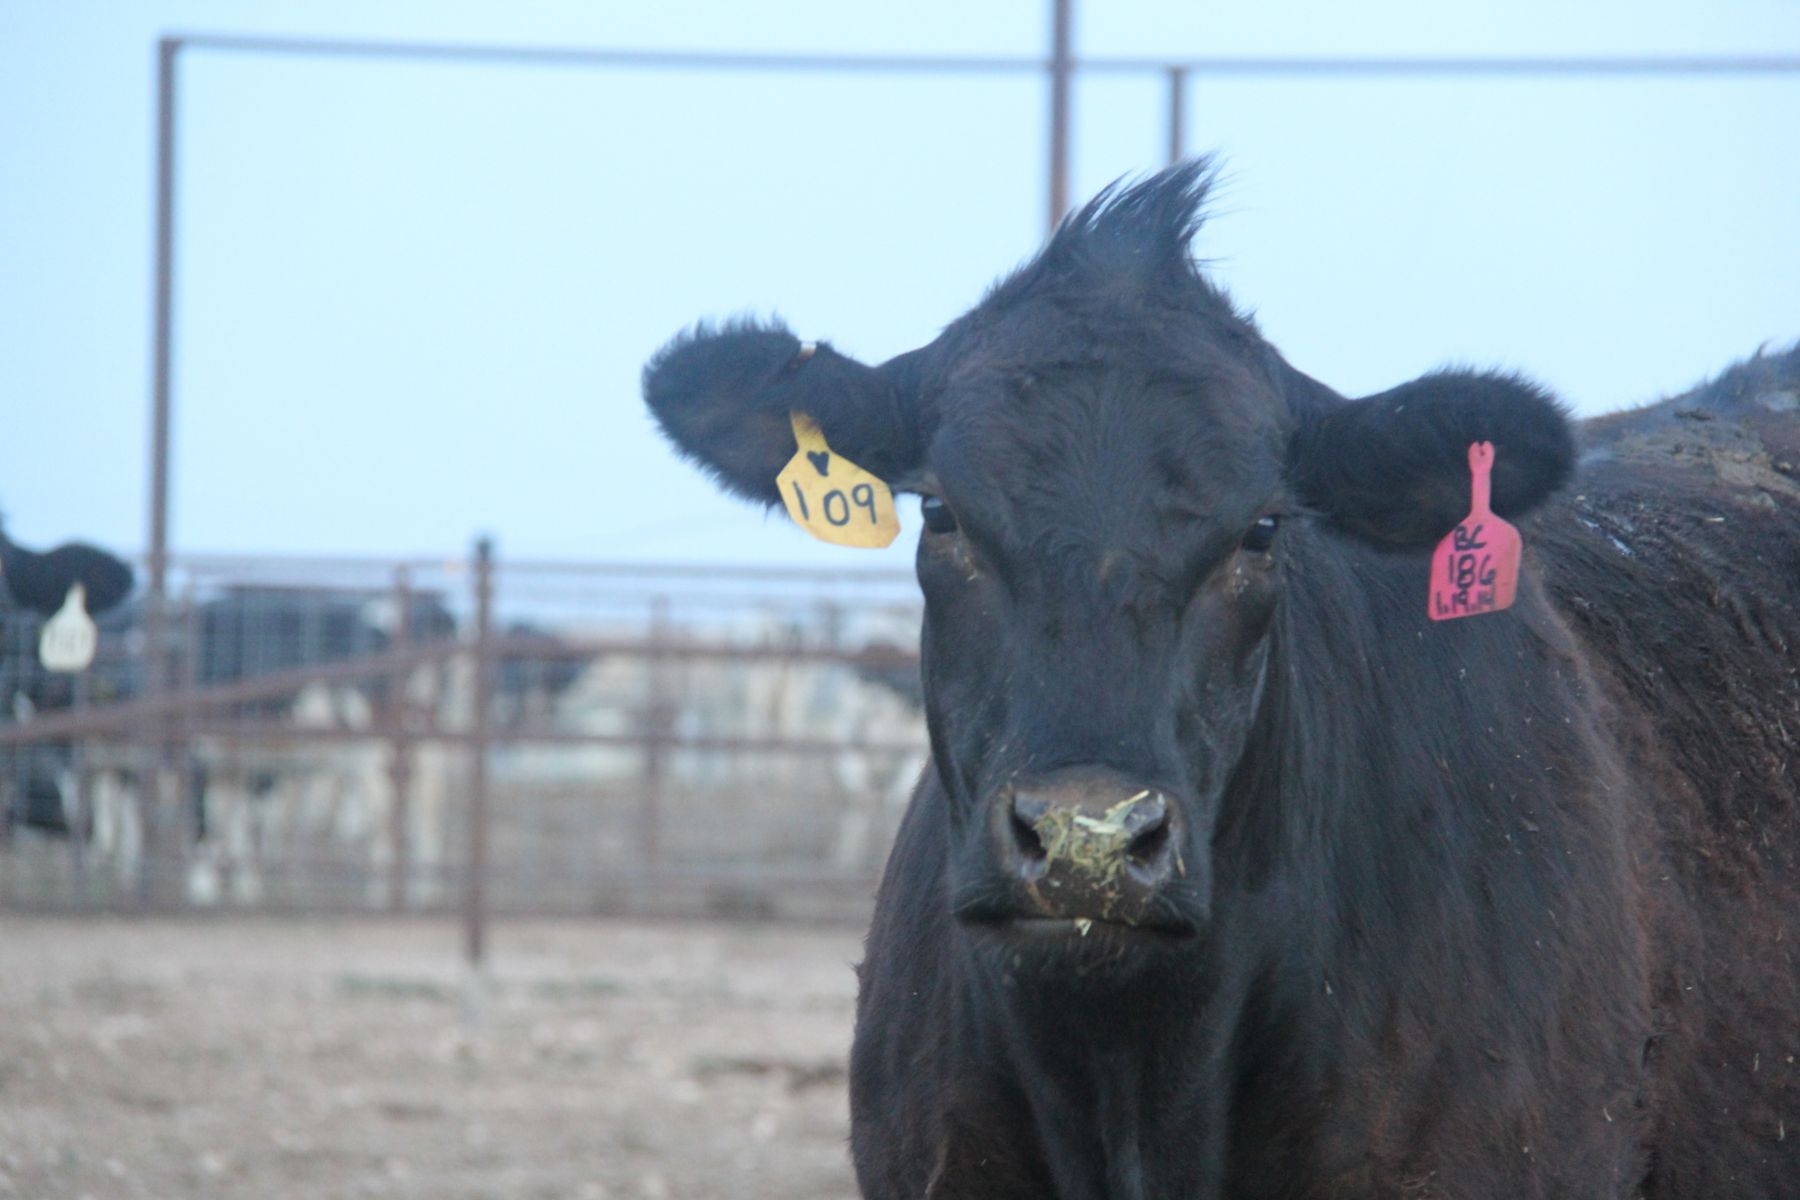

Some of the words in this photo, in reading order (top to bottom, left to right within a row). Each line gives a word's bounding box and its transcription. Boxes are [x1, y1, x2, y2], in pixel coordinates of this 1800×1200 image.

[792, 480, 877, 526] 109
[1454, 525, 1487, 550] BC
[1448, 554, 1497, 588] 186
